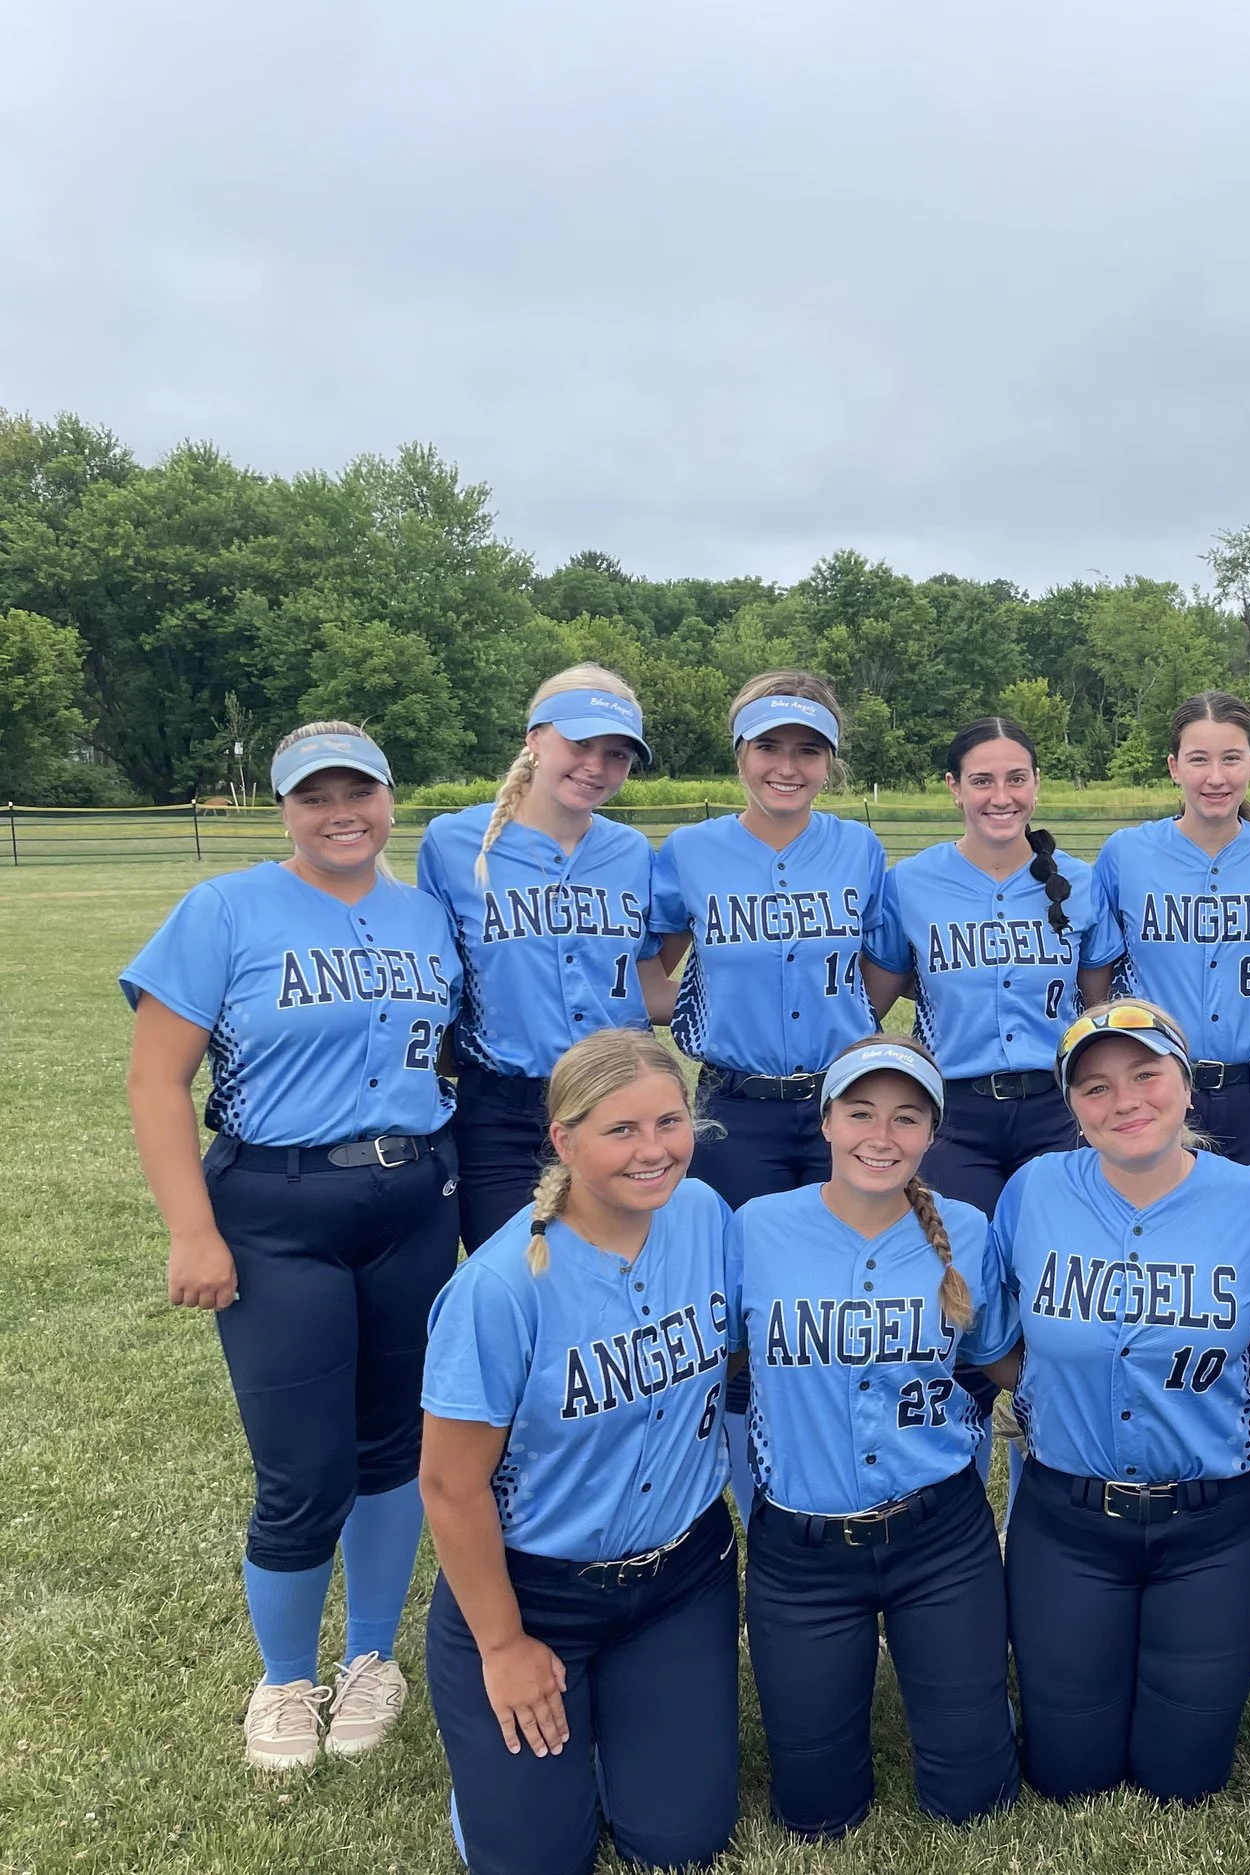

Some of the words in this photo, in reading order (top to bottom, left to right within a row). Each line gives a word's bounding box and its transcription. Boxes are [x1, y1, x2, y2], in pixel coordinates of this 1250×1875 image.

[771, 699, 790, 708] Blue
[791, 701, 816, 714] Angels
[483, 885, 642, 944] ANGELS
[704, 887, 861, 946] ANGELS
[824, 951, 859, 997] 14
[928, 919, 1073, 975] ANGELS
[276, 945, 449, 1010] ANGELS
[611, 954, 628, 999] 1
[1044, 978, 1065, 1020] 0
[884, 1049, 915, 1063] Angels
[1032, 1250, 1238, 1331] ANGELS
[561, 1291, 728, 1419] ANGELS
[766, 1297, 956, 1367] ANGELS
[1163, 1345, 1228, 1394] 10
[697, 1382, 721, 1441] 6
[897, 1378, 954, 1430] 22
